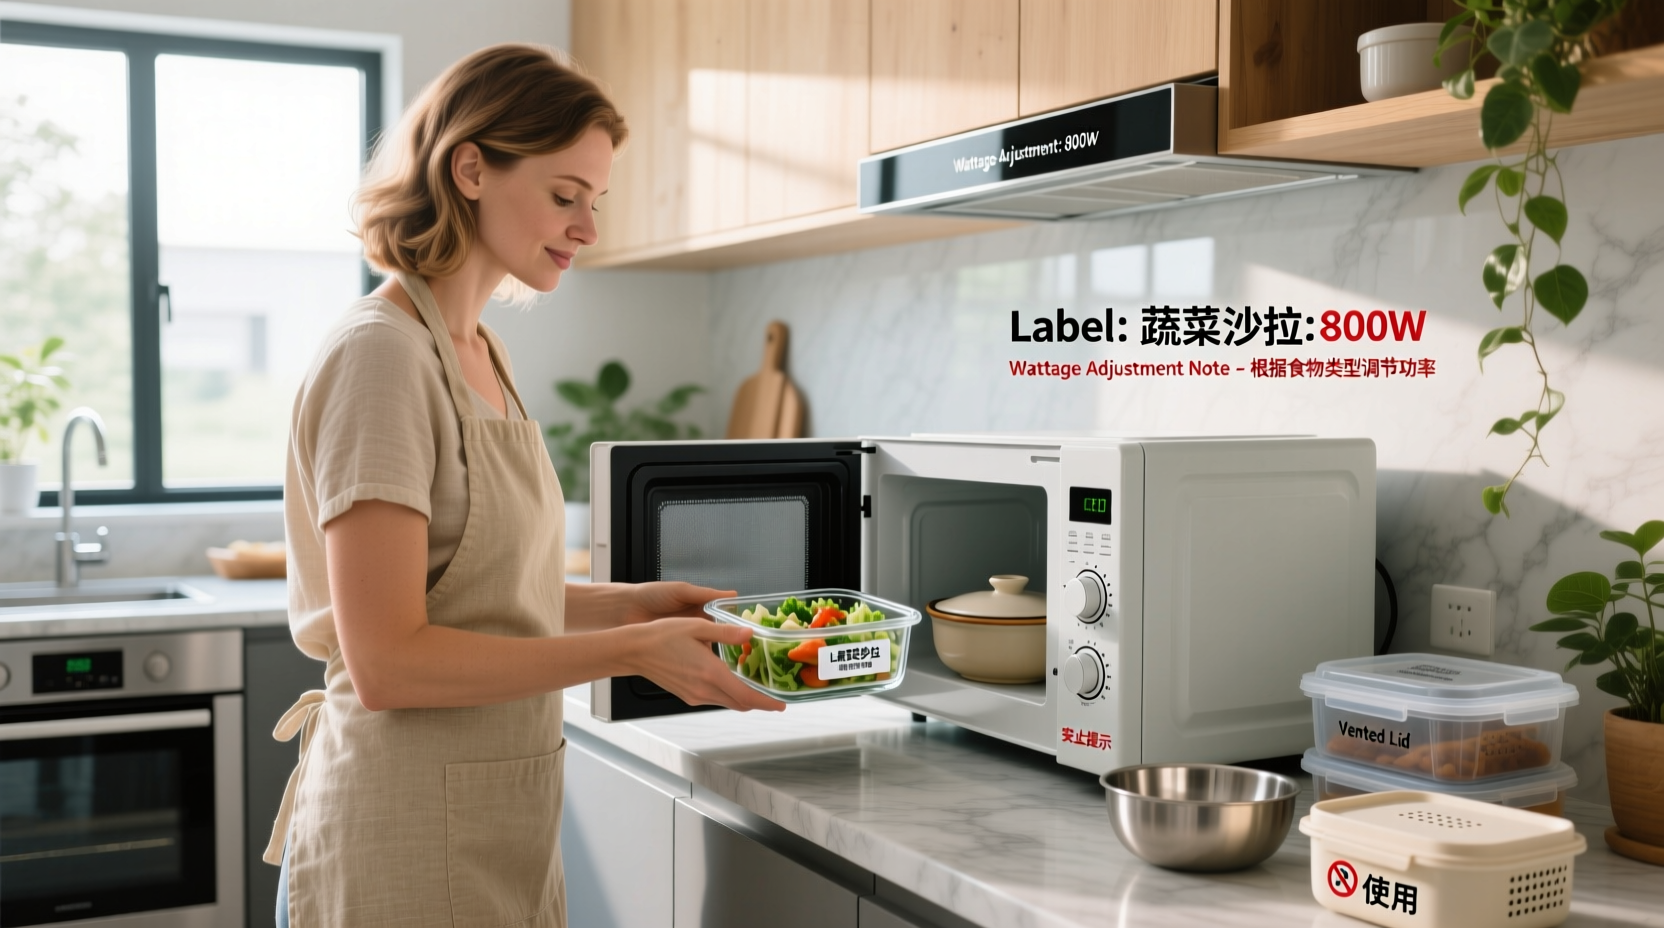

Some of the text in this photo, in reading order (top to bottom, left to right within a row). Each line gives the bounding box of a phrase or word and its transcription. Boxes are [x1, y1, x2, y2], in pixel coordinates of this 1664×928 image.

[1338, 720, 1411, 749] Vented Lid
[1362, 873, 1418, 915] 使用
